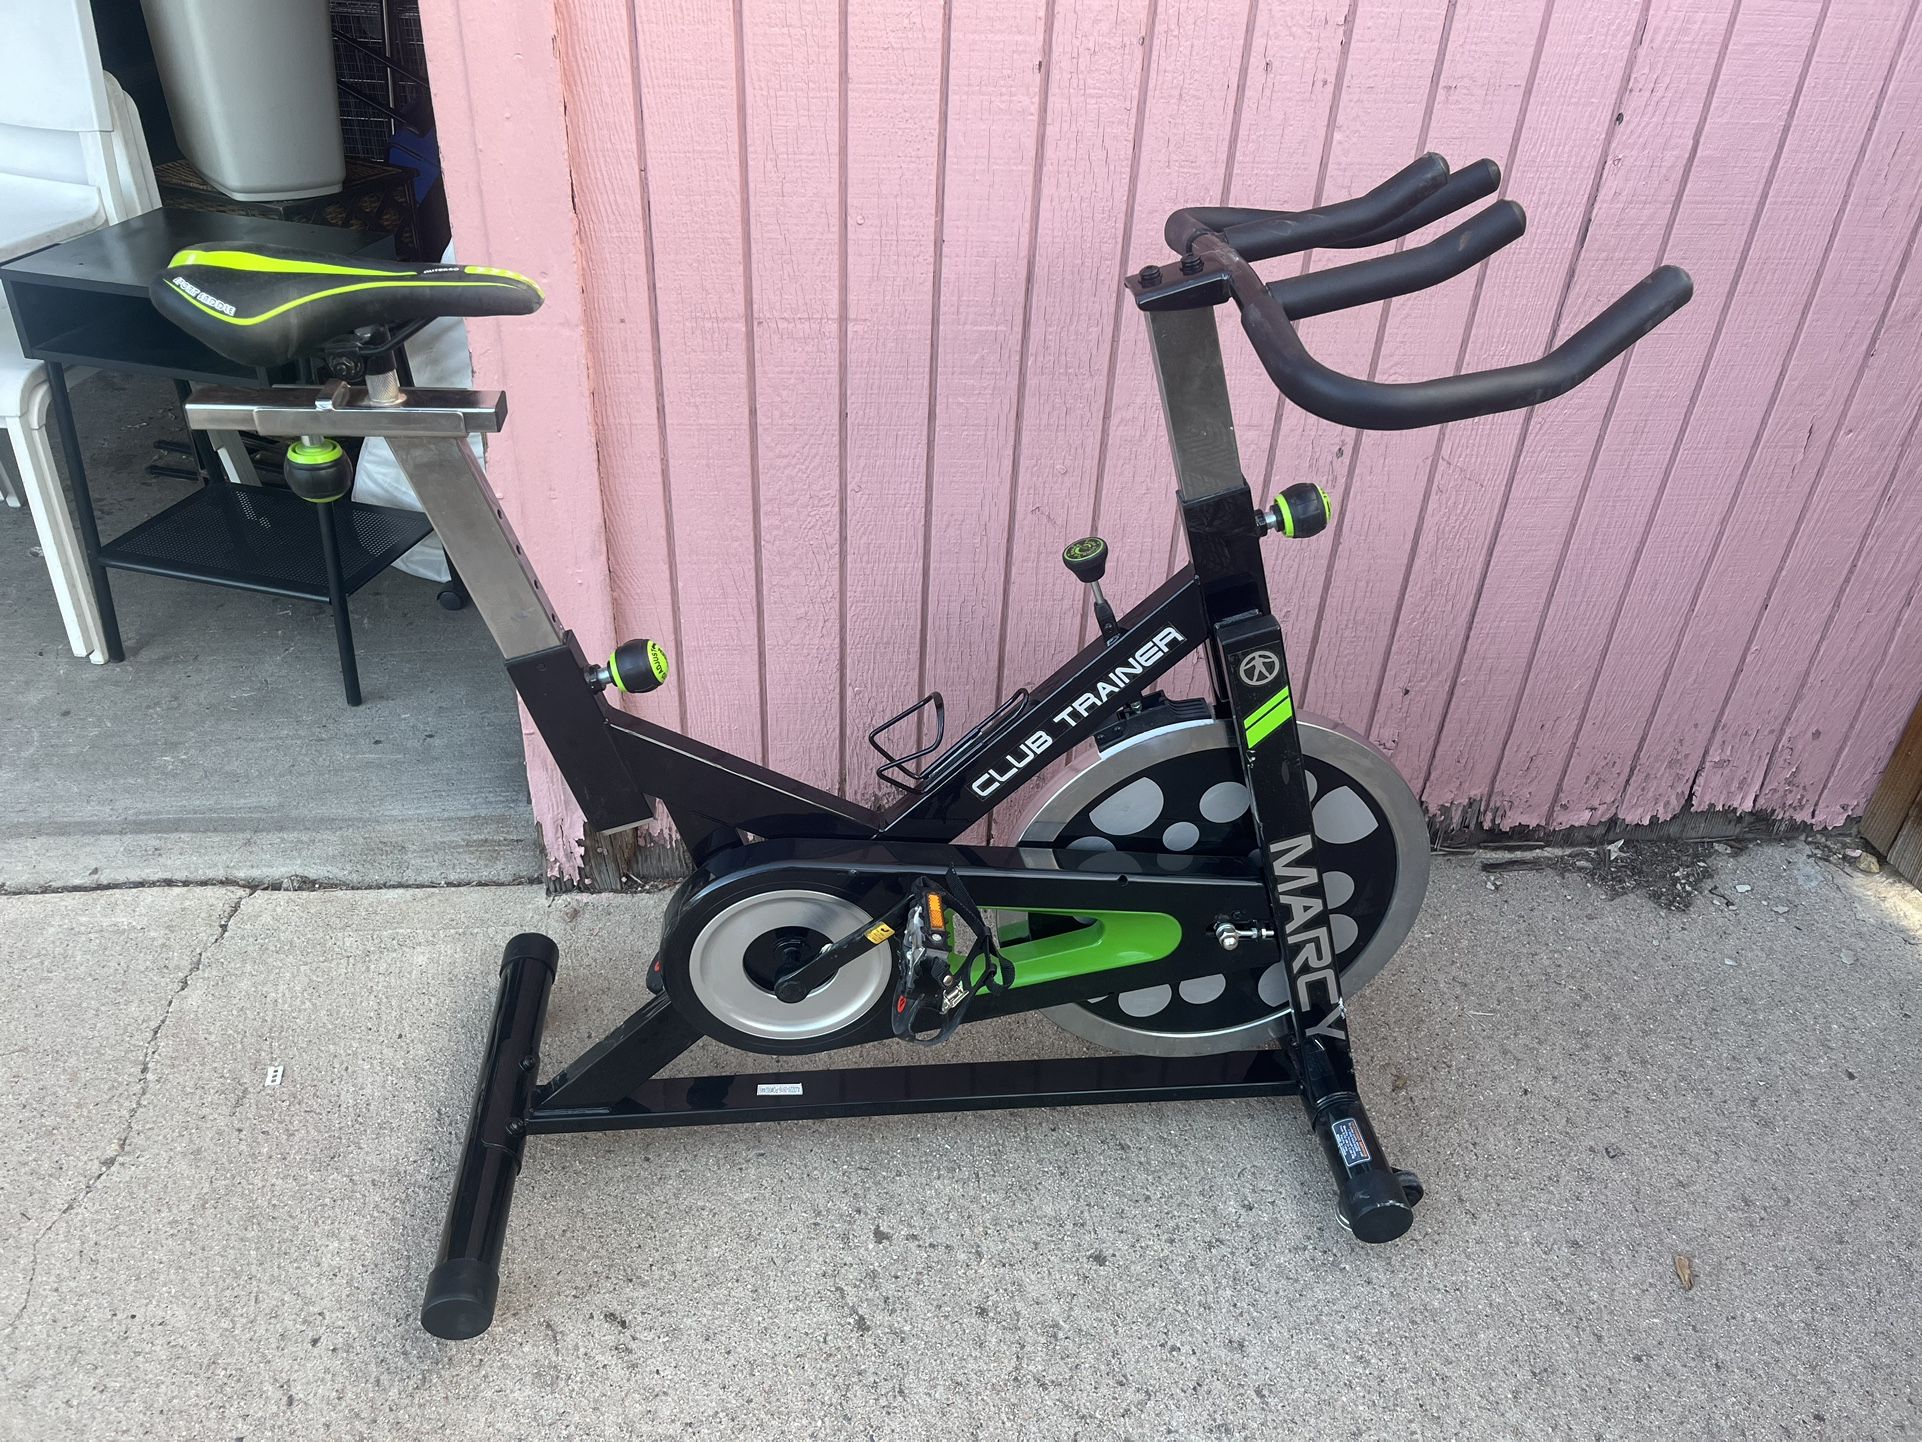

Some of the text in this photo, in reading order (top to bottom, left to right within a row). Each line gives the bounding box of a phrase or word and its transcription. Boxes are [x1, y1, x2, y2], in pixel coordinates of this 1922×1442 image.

[196, 292, 237, 316] SADDLE
[971, 626, 1185, 797] CLUB TRAINER
[1269, 834, 1346, 1040] MARCY
